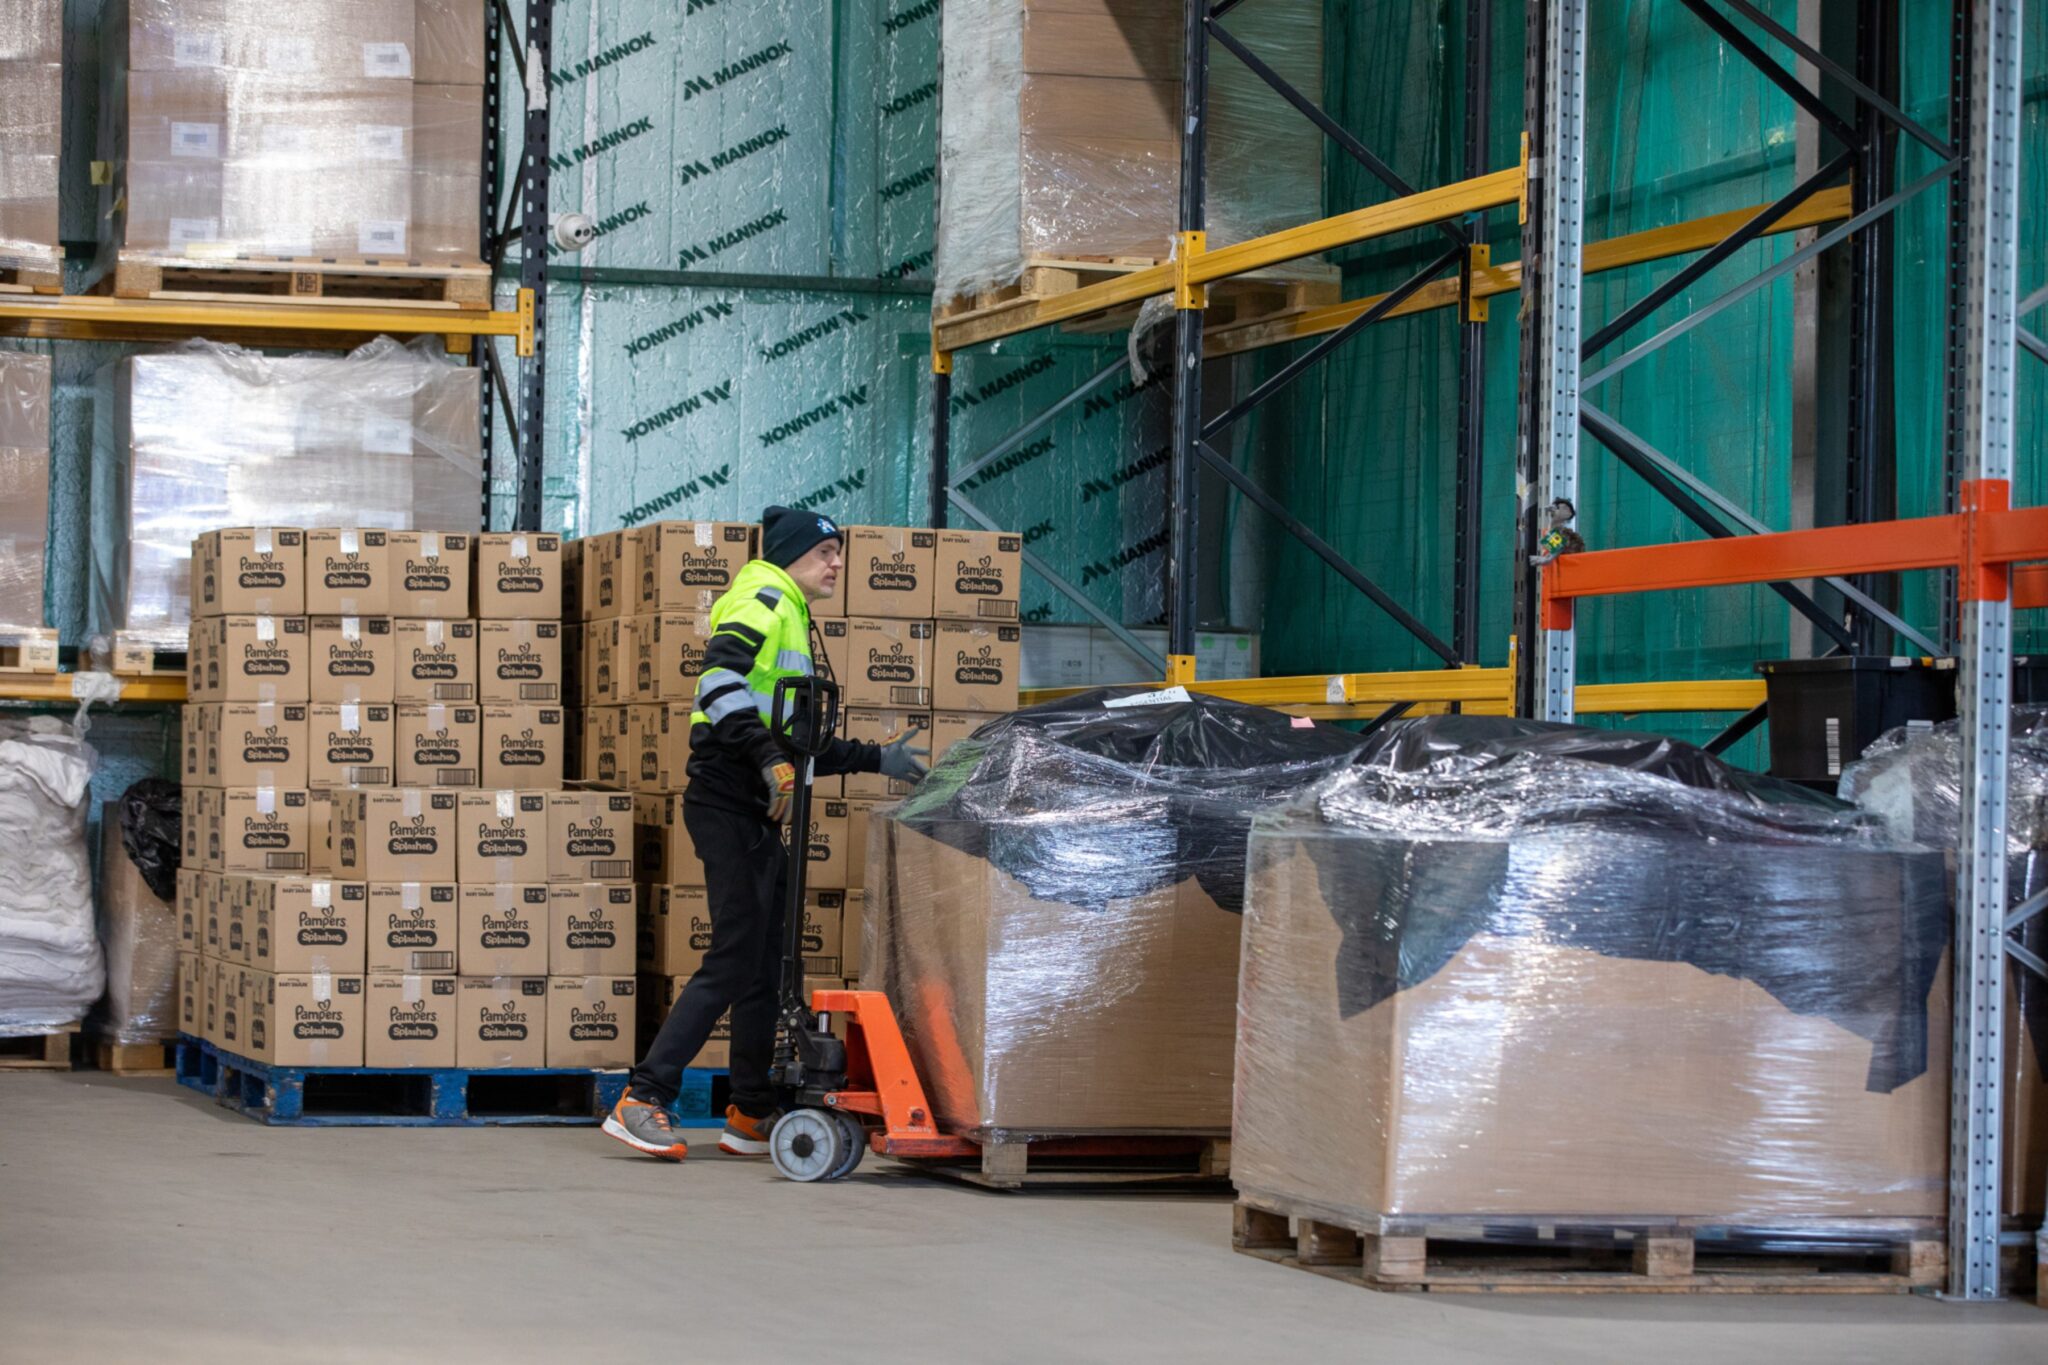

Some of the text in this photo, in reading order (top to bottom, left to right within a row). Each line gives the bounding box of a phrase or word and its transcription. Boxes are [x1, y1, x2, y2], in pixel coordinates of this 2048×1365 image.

[576, 32, 656, 78] MANNOK
[713, 40, 793, 86] MANNOK
[573, 117, 654, 163] MANNOK
[711, 124, 791, 170] MANNOK
[590, 201, 652, 240] ANNOK
[708, 208, 788, 254] MANNOK
[624, 310, 704, 358] MANNOK
[761, 316, 839, 364] MANNOK
[979, 354, 1056, 401] MANNOK
[621, 396, 701, 443] MANNOK
[759, 399, 838, 448] MANNOK
[979, 435, 1056, 484] MANNOK
[1111, 446, 1171, 485] MANNO
[620, 480, 700, 527] MANNOK
[1110, 529, 1170, 570] MANNO
[240, 556, 284, 572] Pampers
[325, 556, 369, 572] Pampers
[406, 560, 449, 575] Pampers
[499, 561, 542, 577] Pampers
[681, 552, 728, 569] Pampers
[870, 557, 916, 574] Pampers
[957, 561, 1002, 578] Pampers
[245, 643, 289, 659] Pampers
[329, 644, 373, 660] Pampers
[413, 648, 456, 664] Pampers
[498, 648, 541, 664] Pampers
[868, 649, 913, 665] Pampers
[957, 651, 1002, 667] Pampers
[244, 730, 288, 746] Pampers
[328, 731, 372, 747] Pampers
[415, 733, 459, 749] Pampers
[501, 734, 544, 750] Pampers
[245, 816, 289, 832] Pampers
[389, 820, 436, 837] Pampers
[479, 823, 525, 839] Pampers
[568, 823, 614, 839] Pampers
[298, 911, 346, 928] Pampers
[388, 913, 435, 930] Pampers
[482, 914, 528, 931] Pampers
[567, 915, 614, 931] Pampers
[295, 1005, 342, 1022] Pampers
[390, 1006, 436, 1023] Pampers
[480, 1007, 526, 1023] Pampers
[571, 1007, 617, 1024] Pampers
